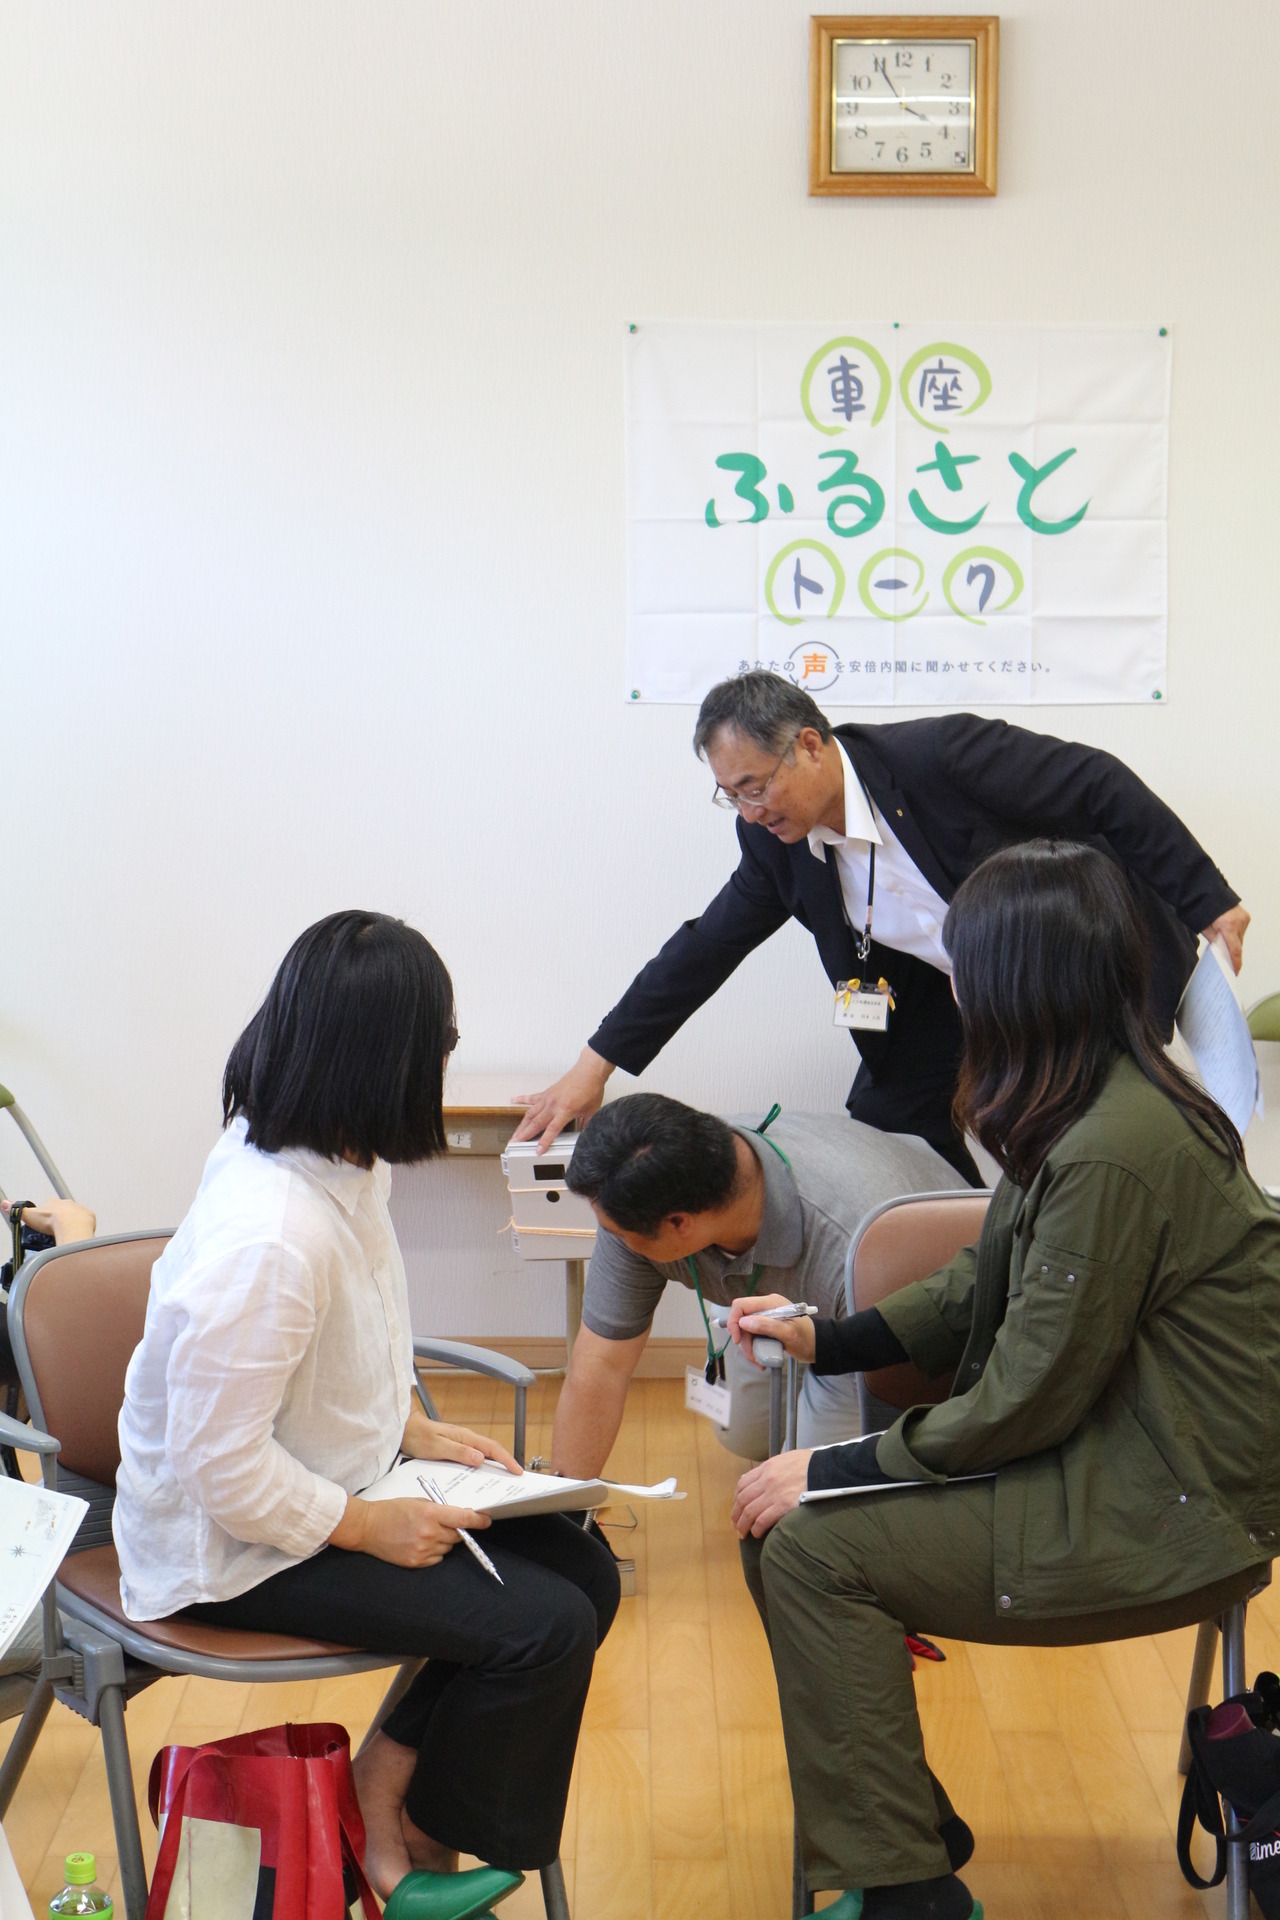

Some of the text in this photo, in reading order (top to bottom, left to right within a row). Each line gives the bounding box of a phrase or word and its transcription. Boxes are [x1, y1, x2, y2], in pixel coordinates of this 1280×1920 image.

[873, 57, 886, 73] 11
[895, 51, 913, 68] 12
[925, 56, 931, 72] 1
[852, 75, 872, 91] 10
[940, 73, 952, 89] 2
[846, 101, 859, 116] 9
[949, 101, 960, 116] 3
[855, 124, 868, 139] 8
[938, 125, 949, 140] 4
[875, 142, 885, 158] 7
[896, 147, 909, 163] 6
[920, 142, 931, 158] 5
[827, 355, 963, 421] 車座
[705, 441, 1092, 538] ふるさと
[793, 557, 996, 613] トーク
[457, 1134, 465, 1144] F
